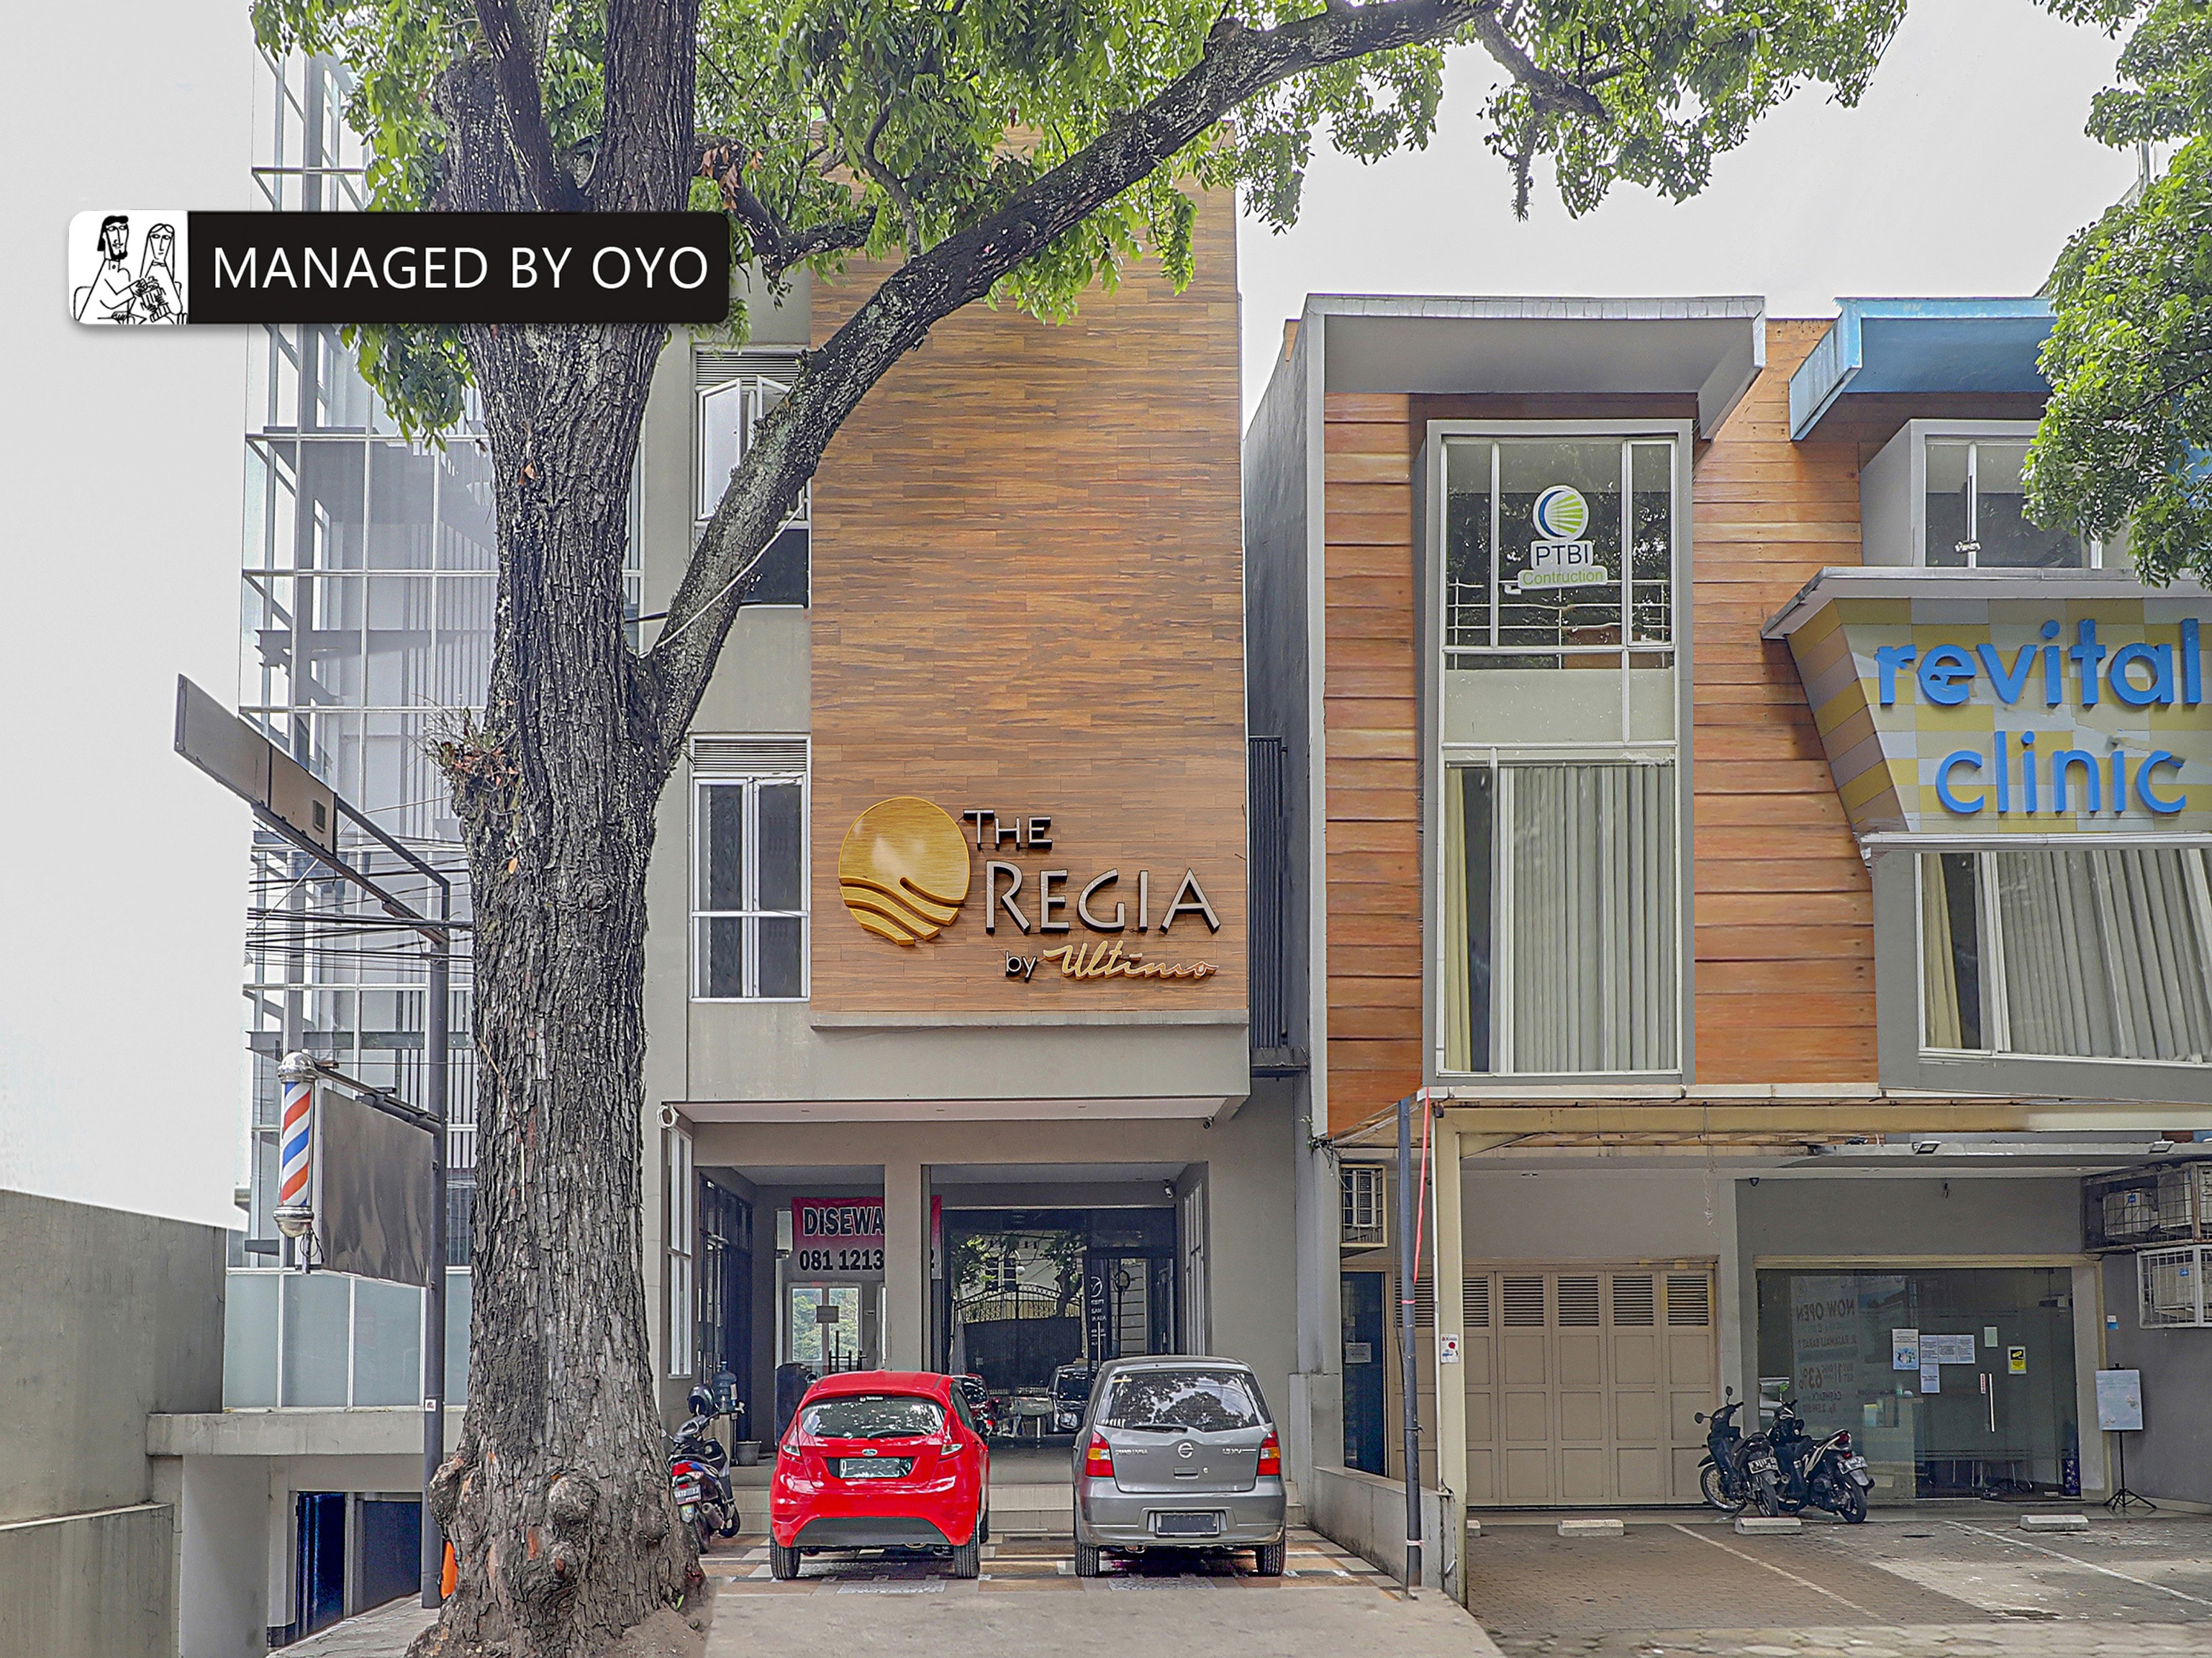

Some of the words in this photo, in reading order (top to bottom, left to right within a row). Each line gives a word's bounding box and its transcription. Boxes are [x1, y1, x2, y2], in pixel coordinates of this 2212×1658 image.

[1535, 543, 1589, 566] PTBI
[1522, 570, 1604, 586] Contruction
[1874, 617, 2203, 706] revital
[1935, 730, 2187, 814] clinic
[962, 808, 1053, 851] THE
[985, 860, 1221, 935] REGIA
[1005, 951, 1038, 983] by
[1042, 940, 1220, 980] Ultimo
[799, 1249, 833, 1271] 081
[838, 1249, 884, 1271] 1213
